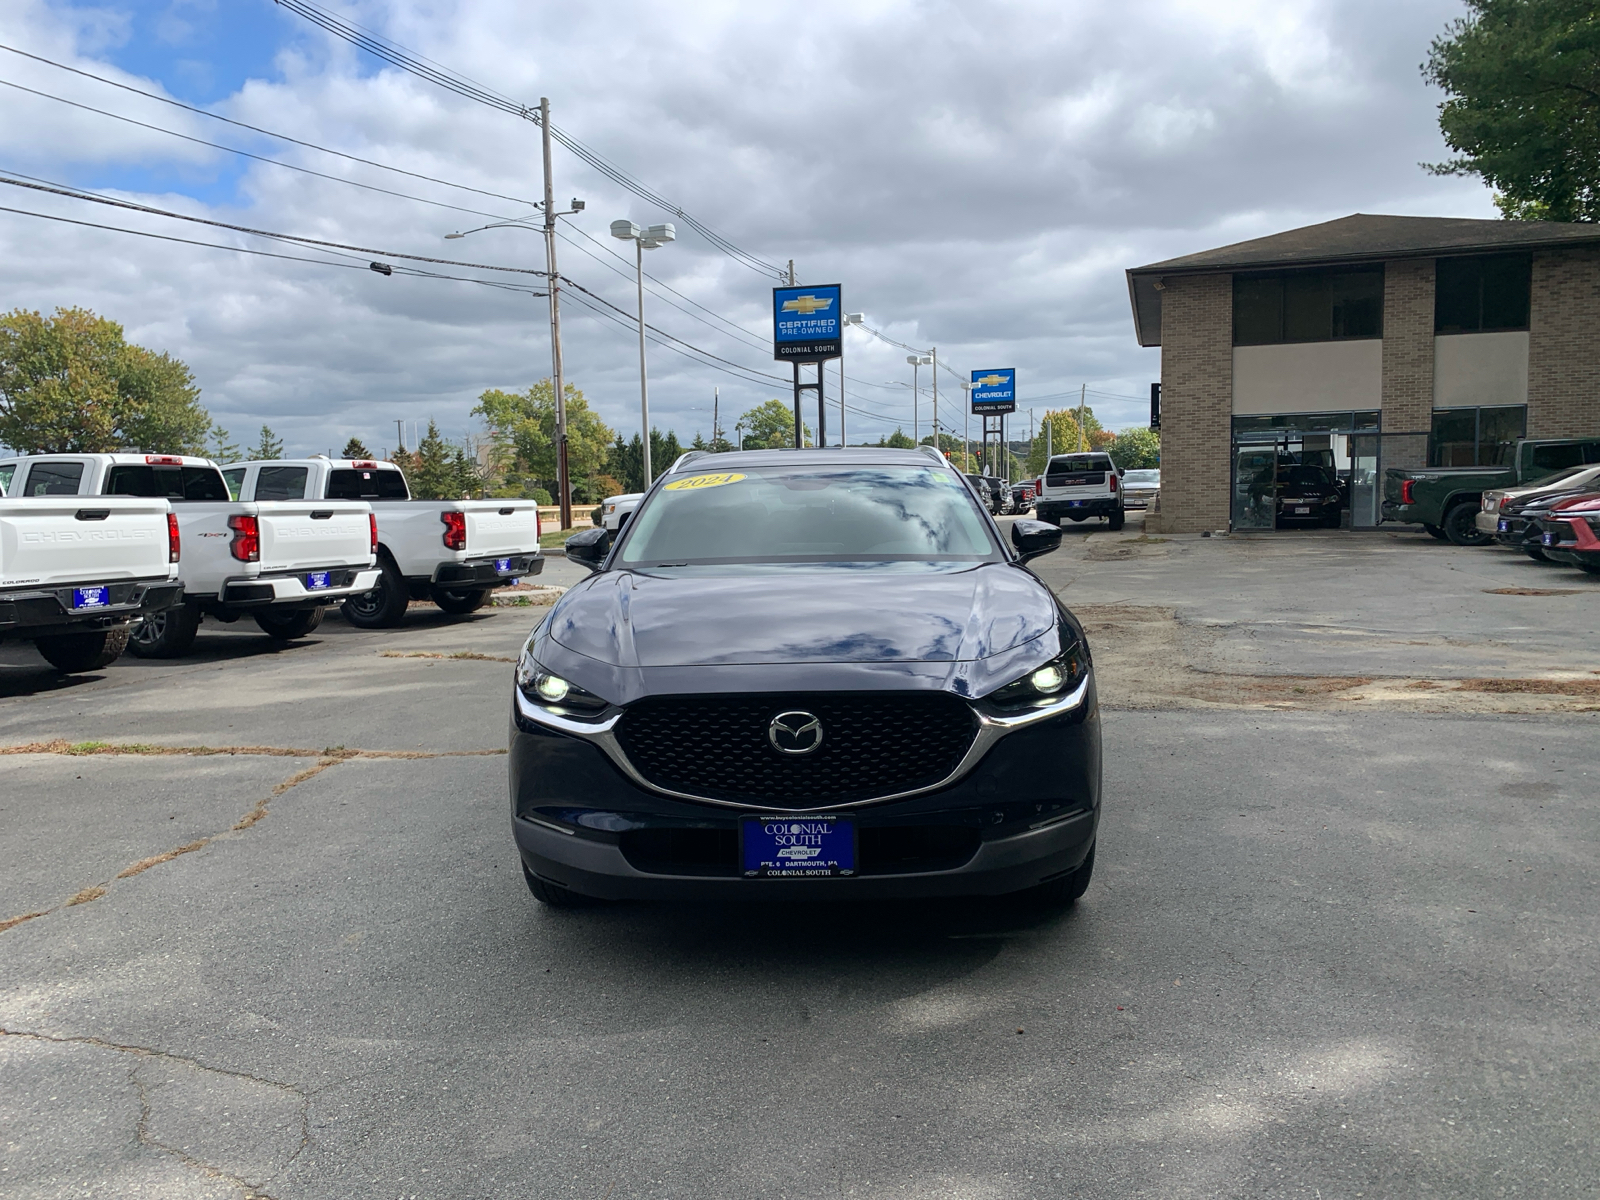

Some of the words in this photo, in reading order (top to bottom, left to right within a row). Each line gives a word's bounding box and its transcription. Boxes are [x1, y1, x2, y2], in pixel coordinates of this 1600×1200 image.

[779, 319, 836, 329] CERTIFIED
[782, 326, 833, 335] PRE-OWNED
[781, 345, 811, 354] COLONIAL
[975, 391, 1012, 399] CHEVROLET
[676, 474, 734, 490] 2024
[477, 520, 533, 531] CHEVROLET
[22, 528, 157, 544] CHEVROLET
[277, 525, 364, 538] CHEVROLET
[764, 823, 832, 835] COLONIAL
[775, 835, 822, 846] SOUTH
